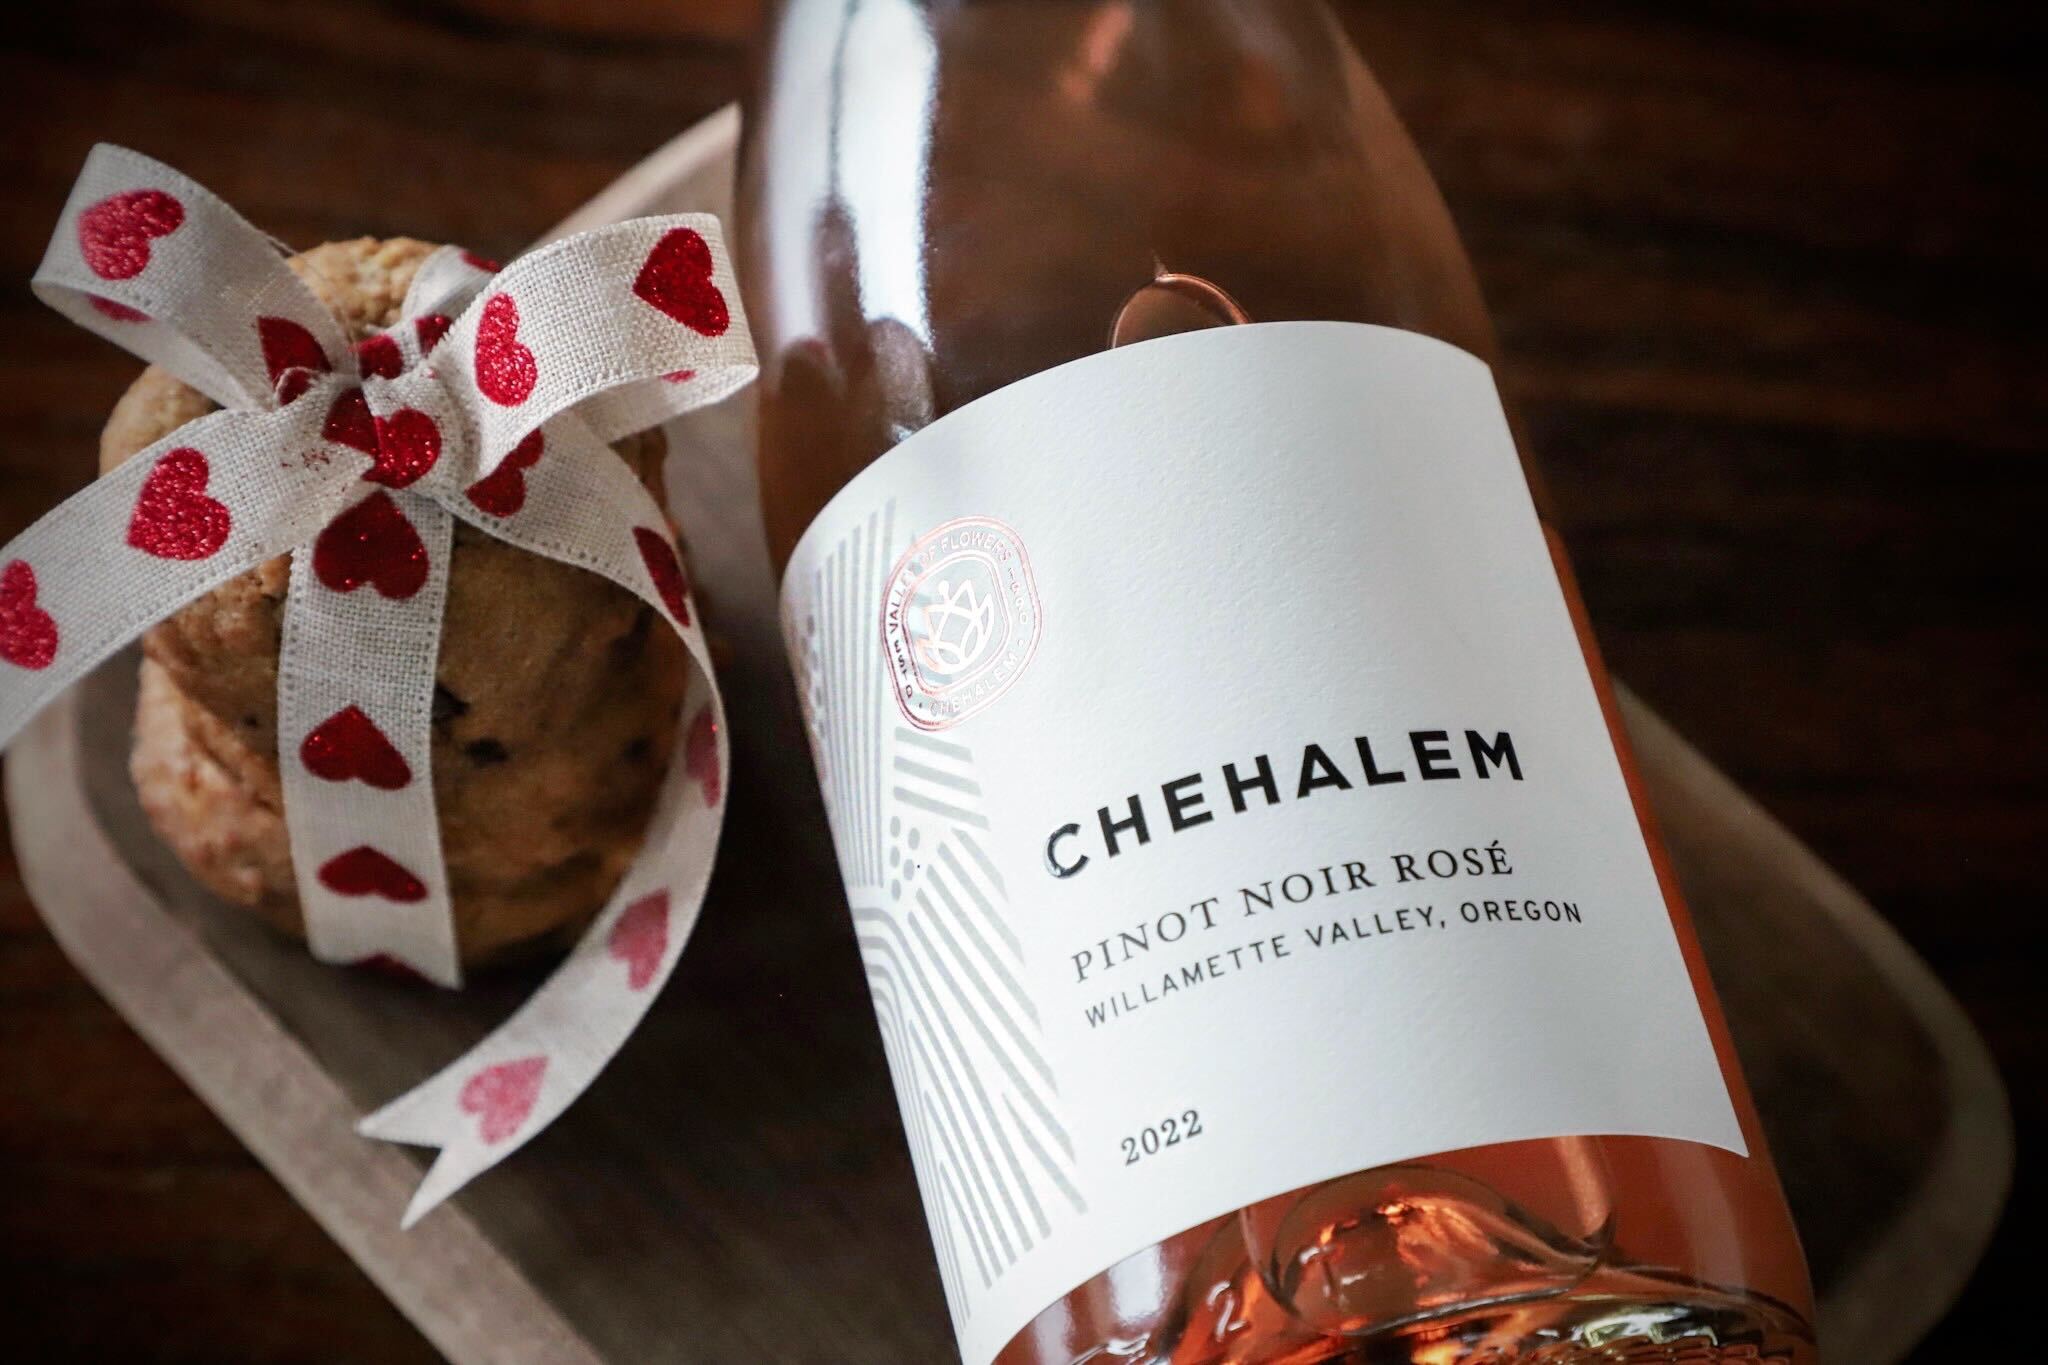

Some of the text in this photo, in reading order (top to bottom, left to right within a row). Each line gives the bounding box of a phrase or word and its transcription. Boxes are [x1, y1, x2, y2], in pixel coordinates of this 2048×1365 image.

[941, 530, 1012, 563] FLOWERS
[929, 654, 1018, 717] CHEHALEM
[1043, 729, 1525, 881] CHEHALEM
[1070, 840, 1514, 983] PINOT NOIR ROSÉ
[1084, 899, 1583, 1029] WILLAMETTE VALLEY, OREGON
[1121, 1108, 1203, 1166] 2022
